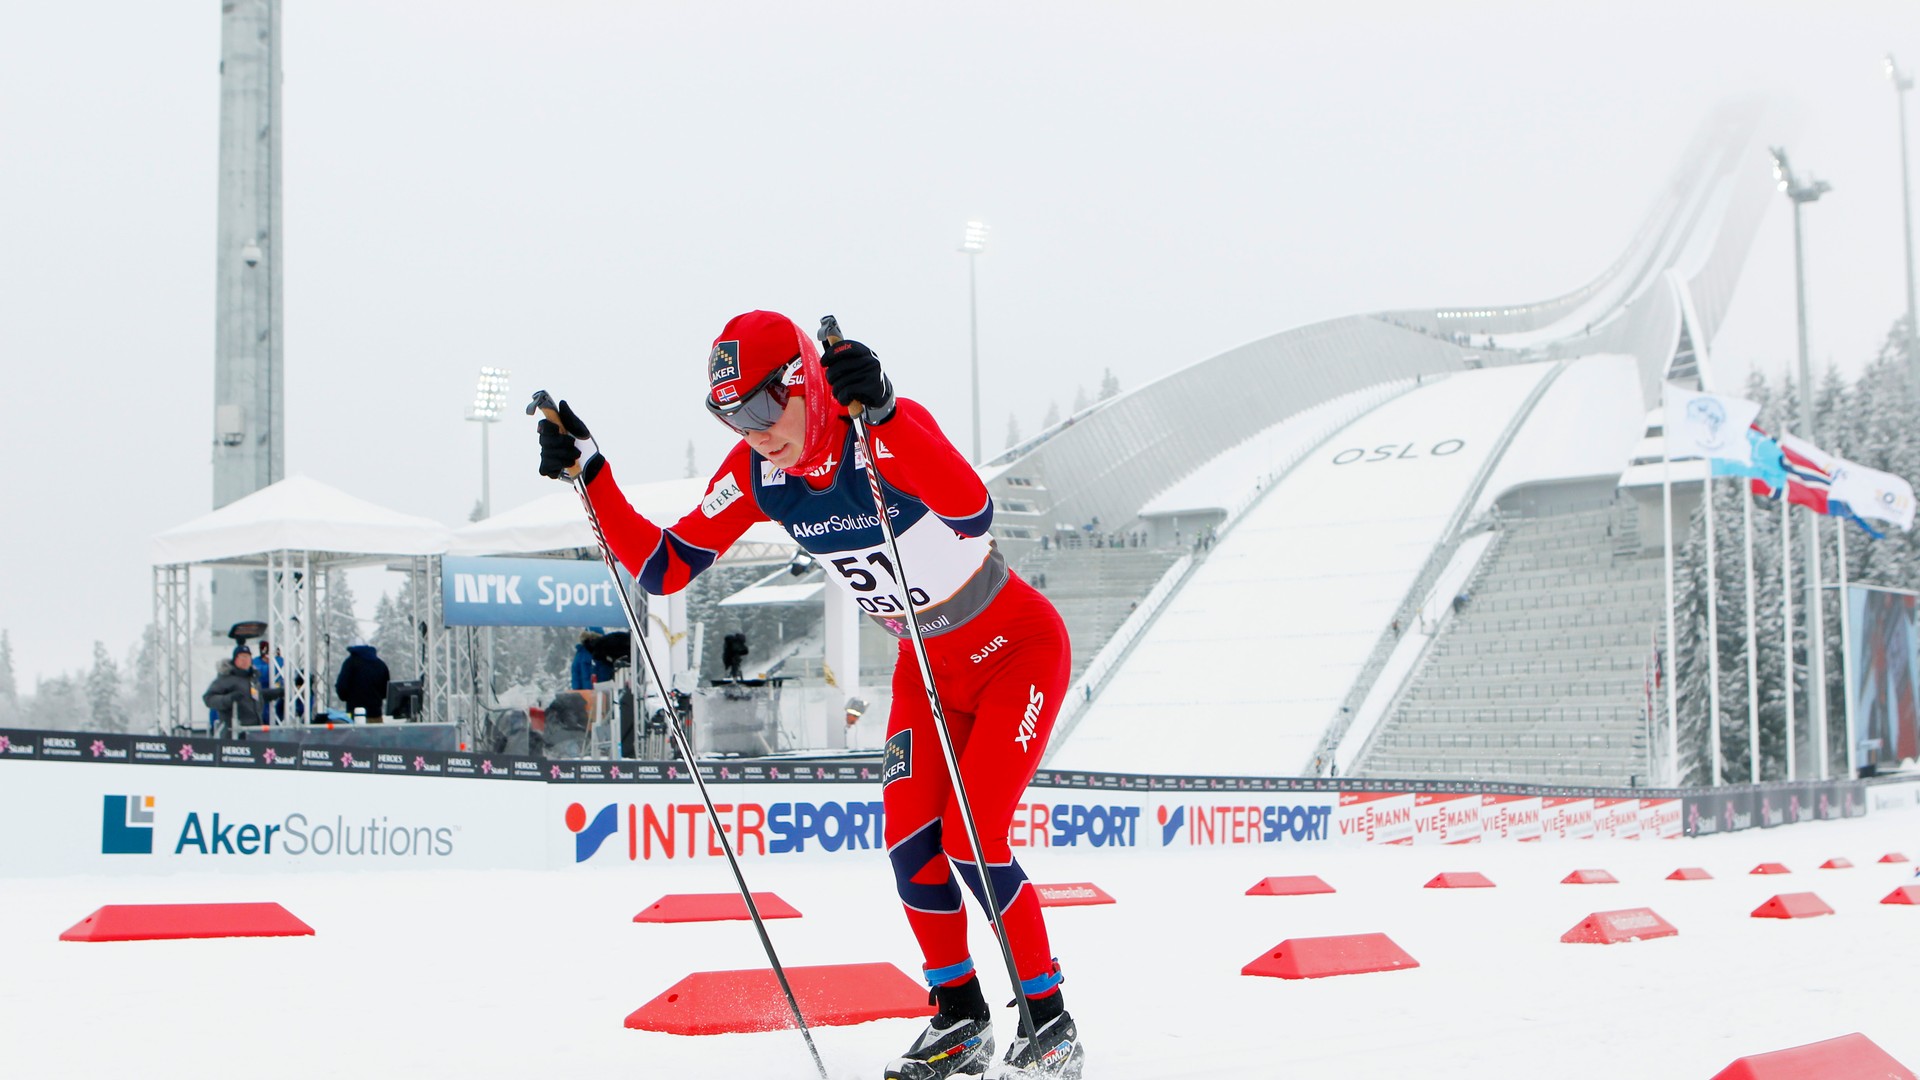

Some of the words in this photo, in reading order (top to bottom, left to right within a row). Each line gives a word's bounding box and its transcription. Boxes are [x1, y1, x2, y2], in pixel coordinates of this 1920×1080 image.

[712, 366, 735, 382] AKER
[1332, 439, 1465, 465] OSLO
[703, 484, 740, 513] TERA
[793, 506, 900, 538] AkerSolutios
[831, 551, 898, 591] 51
[538, 576, 613, 612] Sport
[970, 635, 1008, 664] SJUR
[43, 738, 76, 750] HEROES
[135, 742, 167, 752] HEROES
[222, 746, 251, 755] HEROES
[174, 812, 454, 856] AkerSolutions
[629, 801, 886, 861] INTERSPORT
[1010, 804, 1141, 848] ERSPORT
[1189, 805, 1332, 846] INTERSPORT
[1339, 807, 1411, 841] VIESSMANN
[1415, 806, 1478, 839] VIESSMANN
[1482, 807, 1539, 838] VIESSMANN
